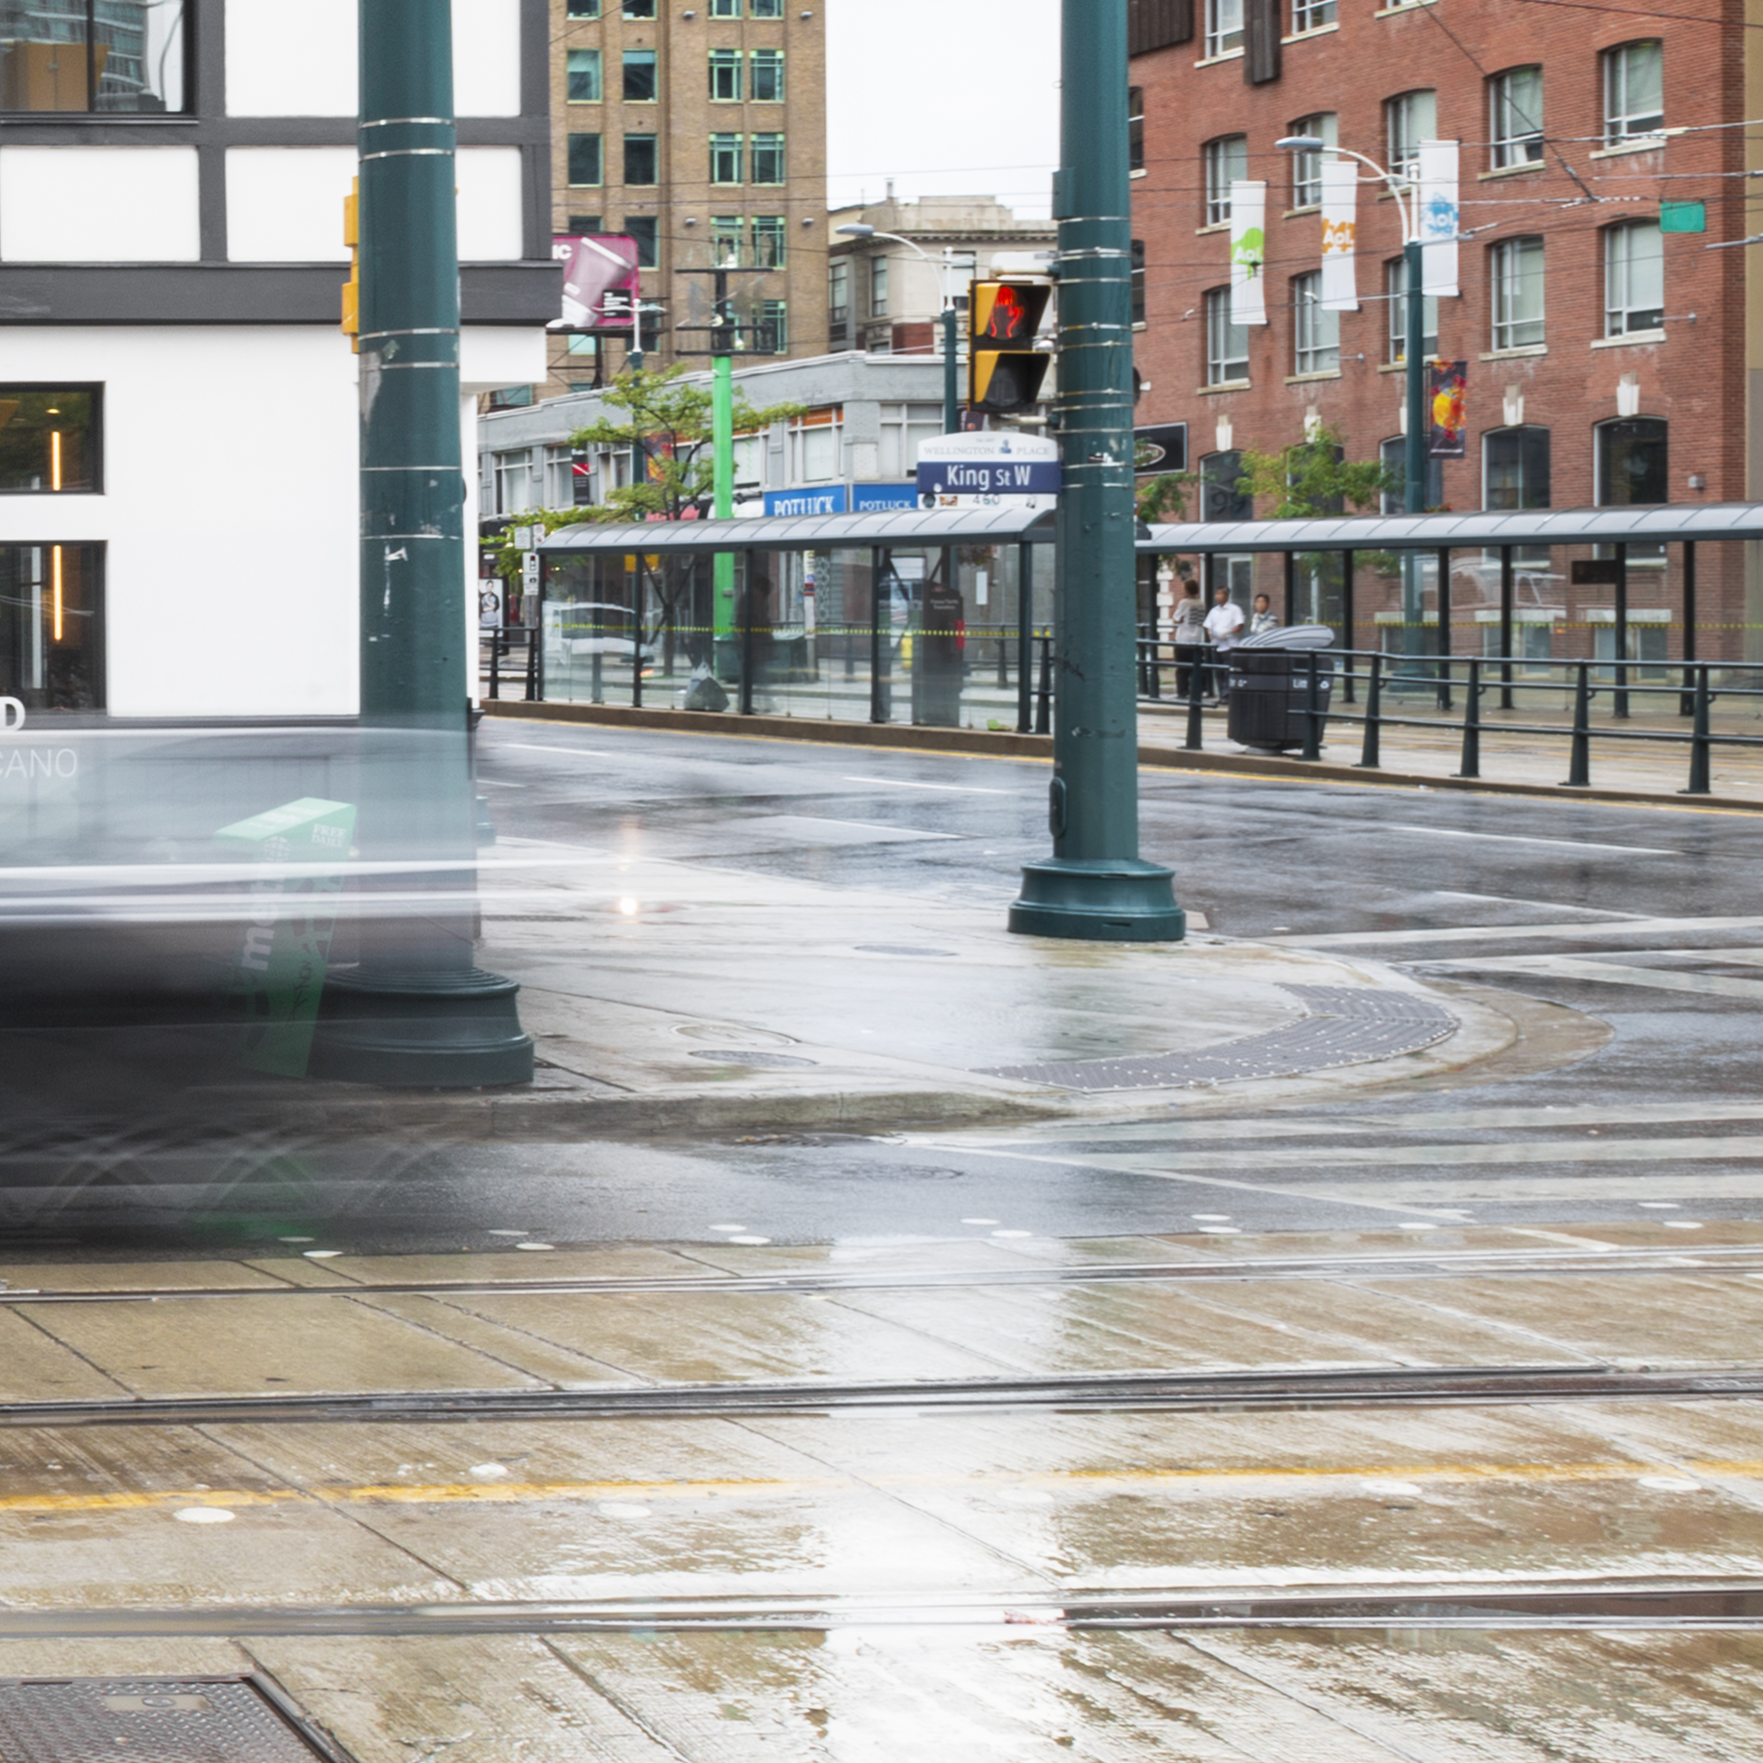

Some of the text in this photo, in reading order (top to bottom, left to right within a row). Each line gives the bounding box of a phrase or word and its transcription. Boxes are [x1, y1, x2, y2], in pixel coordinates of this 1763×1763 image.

[924, 447, 1050, 455] WELLINGTON PLACE
[947, 464, 1032, 491] King St W
[774, 496, 834, 516] POTLUCK
[859, 499, 913, 511] POTLUCK
[313, 822, 348, 839] FREE
